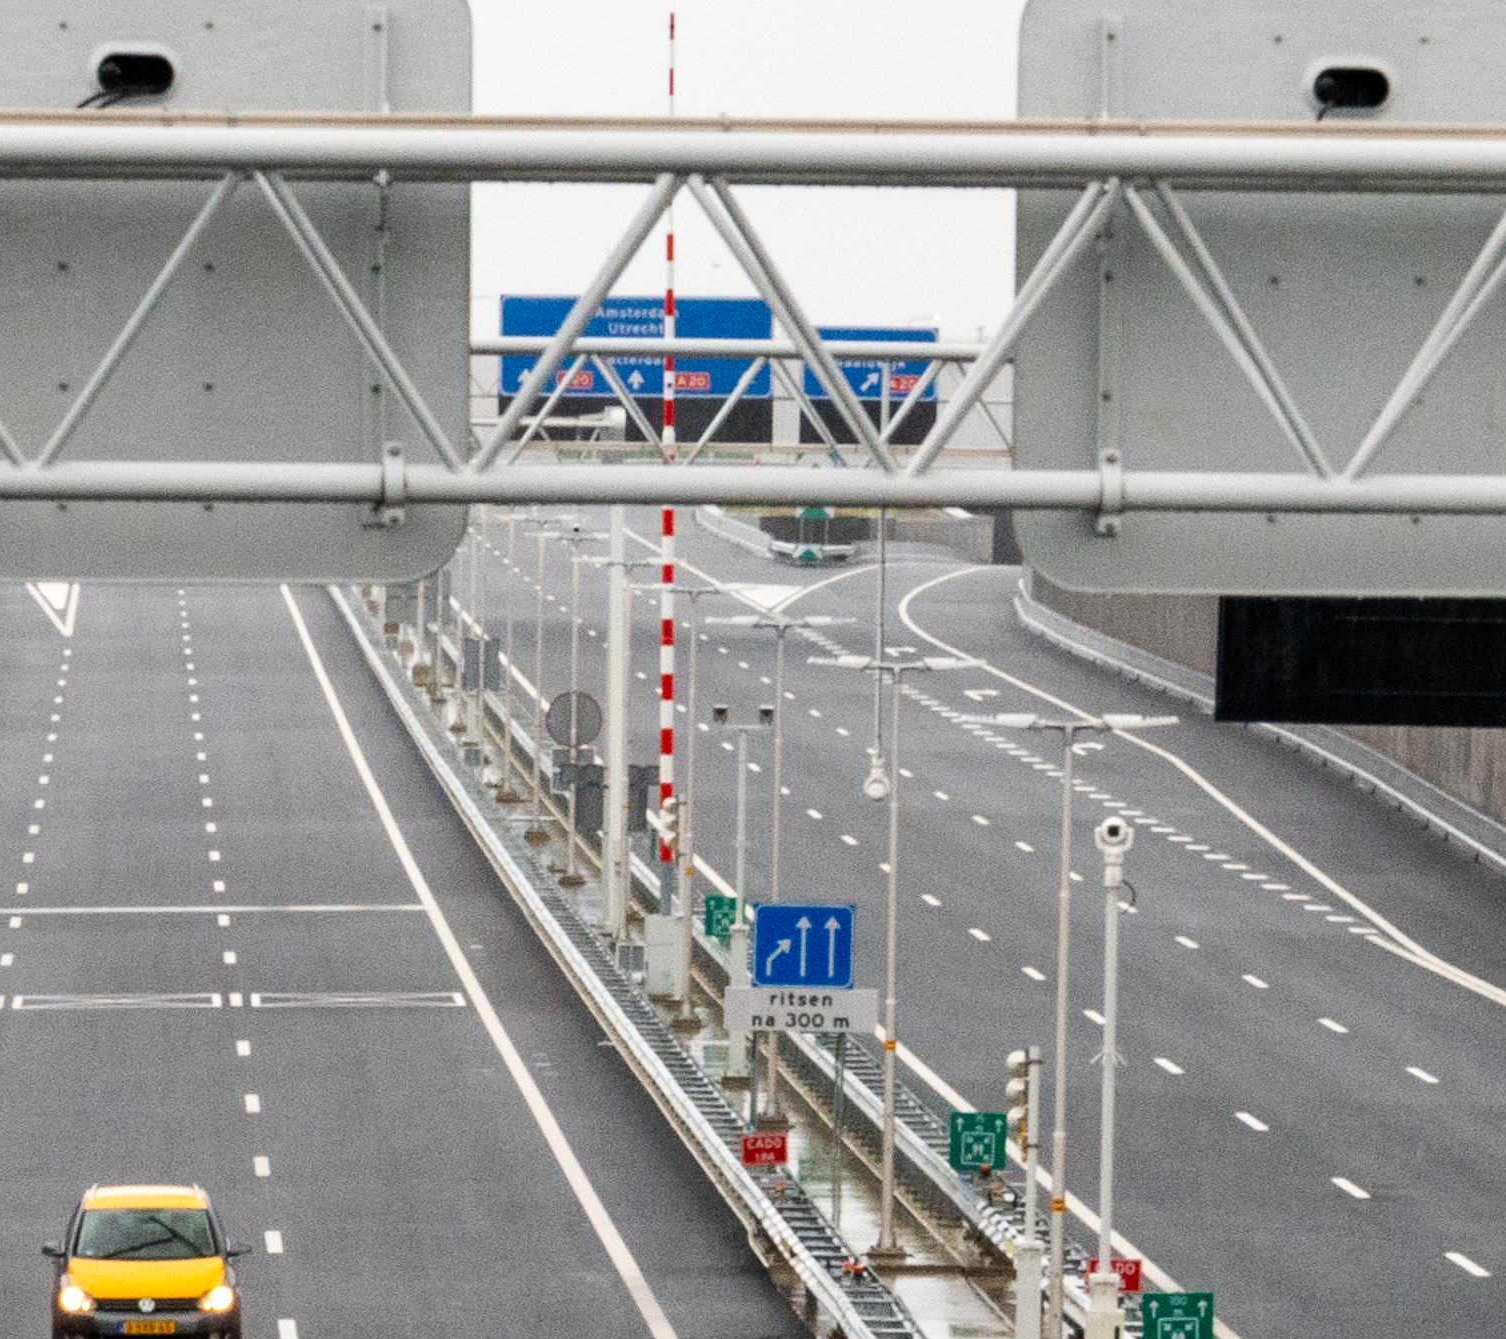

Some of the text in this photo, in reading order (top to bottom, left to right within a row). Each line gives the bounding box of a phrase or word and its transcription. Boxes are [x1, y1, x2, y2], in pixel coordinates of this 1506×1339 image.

[769, 992, 834, 1007] ritsen
[752, 1012, 850, 1029] na 300 m
